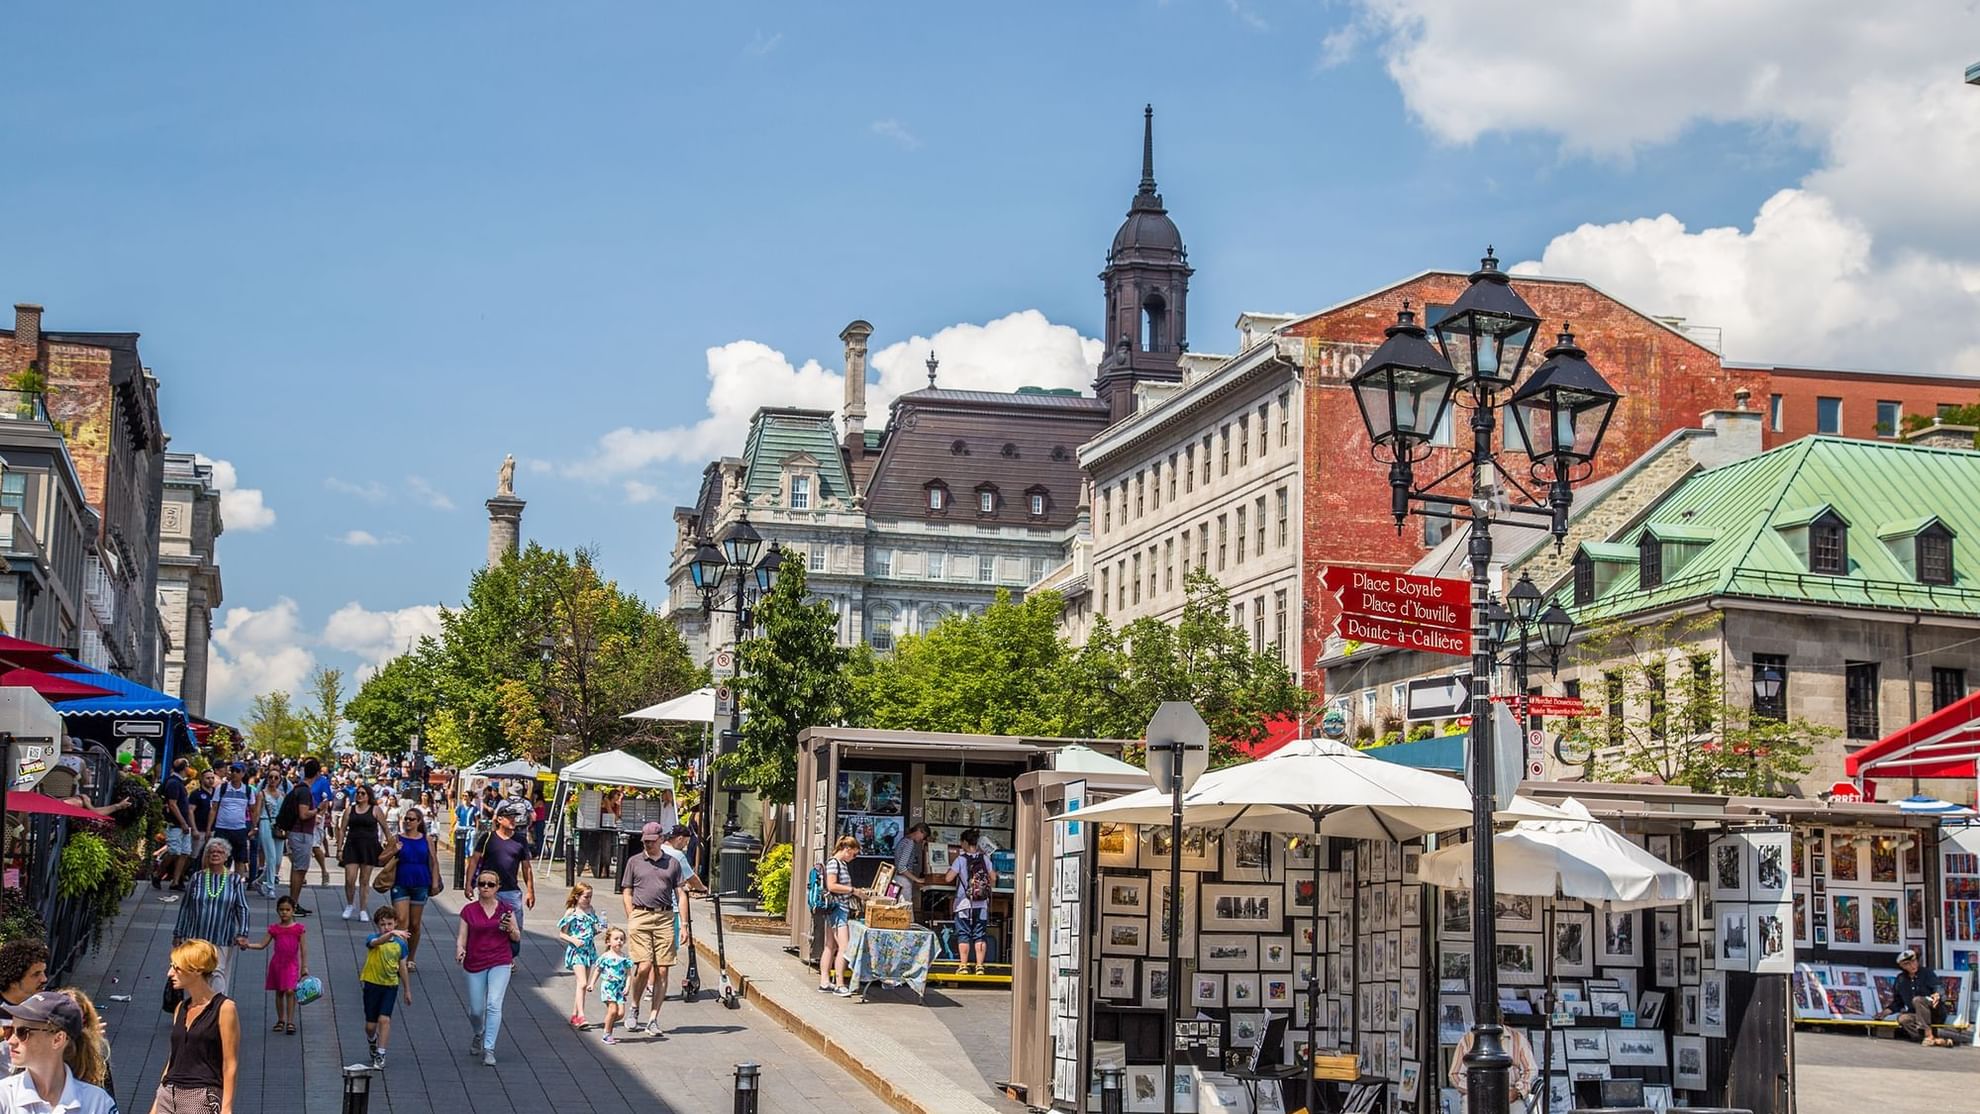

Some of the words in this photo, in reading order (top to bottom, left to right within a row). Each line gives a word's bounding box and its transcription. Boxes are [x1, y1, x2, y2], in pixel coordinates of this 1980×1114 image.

[1353, 572, 1390, 592] Place
[1395, 577, 1442, 598] Royale
[1362, 593, 1396, 613] Place
[1400, 600, 1457, 623] d'Youville
[1348, 619, 1463, 651] Pointe-à-Callière
